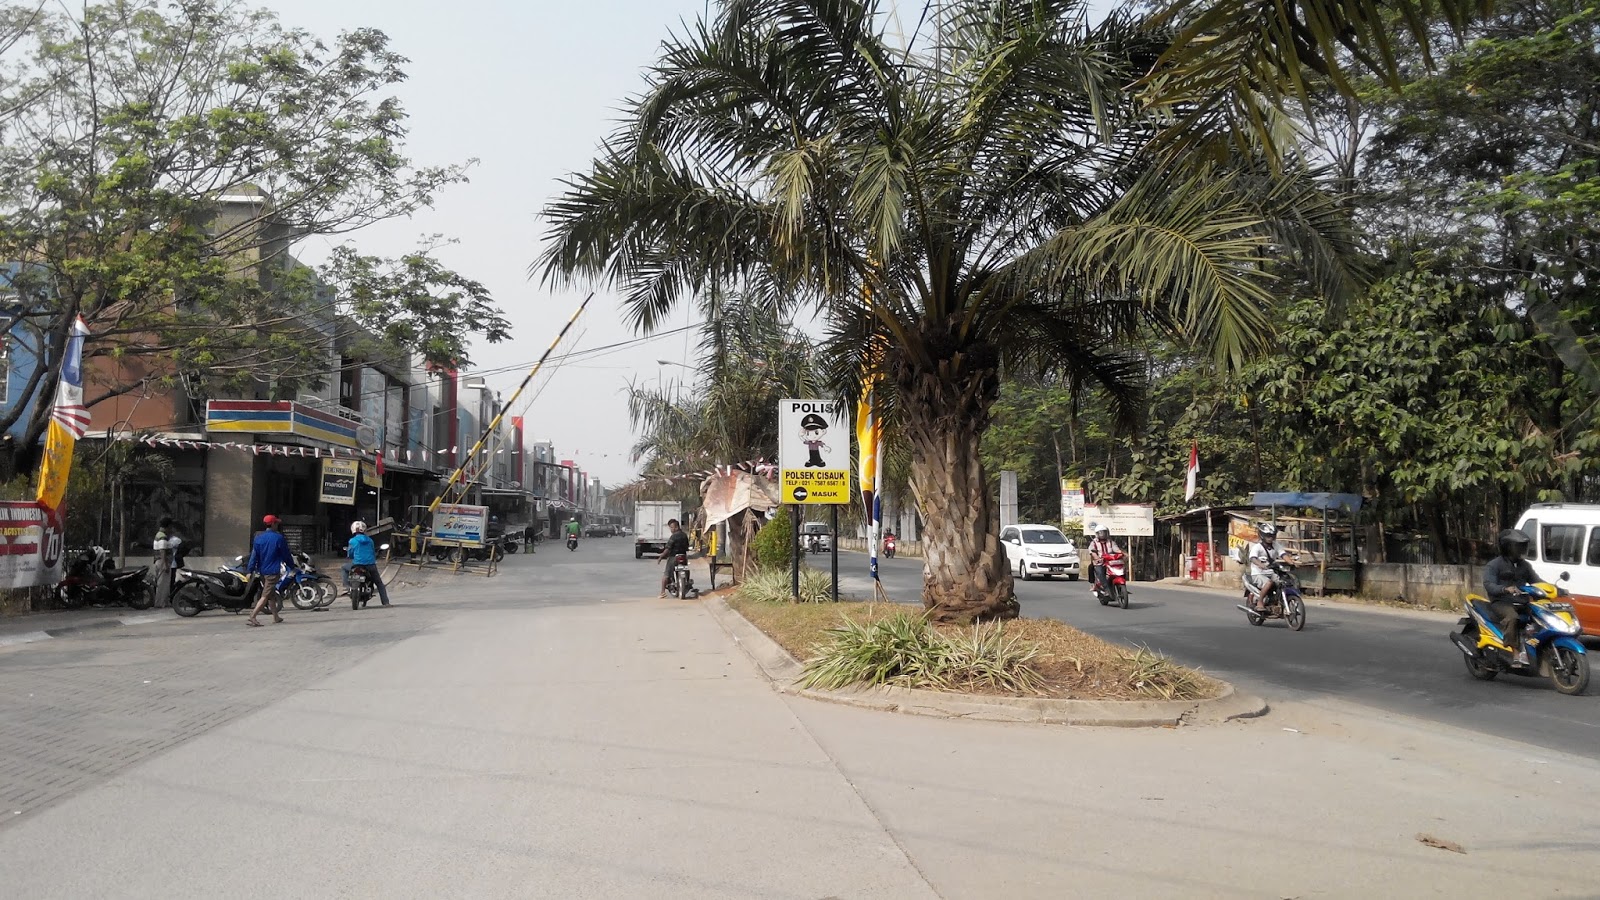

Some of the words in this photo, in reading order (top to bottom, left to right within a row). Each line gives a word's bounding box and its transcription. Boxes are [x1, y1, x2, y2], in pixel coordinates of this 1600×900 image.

[792, 403, 838, 413] POLIS
[785, 471, 815, 480] POLSEK
[816, 471, 845, 480] CISAUK
[10, 507, 42, 521] INDONESIA
[453, 523, 480, 531] Delivery
[44, 527, 60, 561] 70
